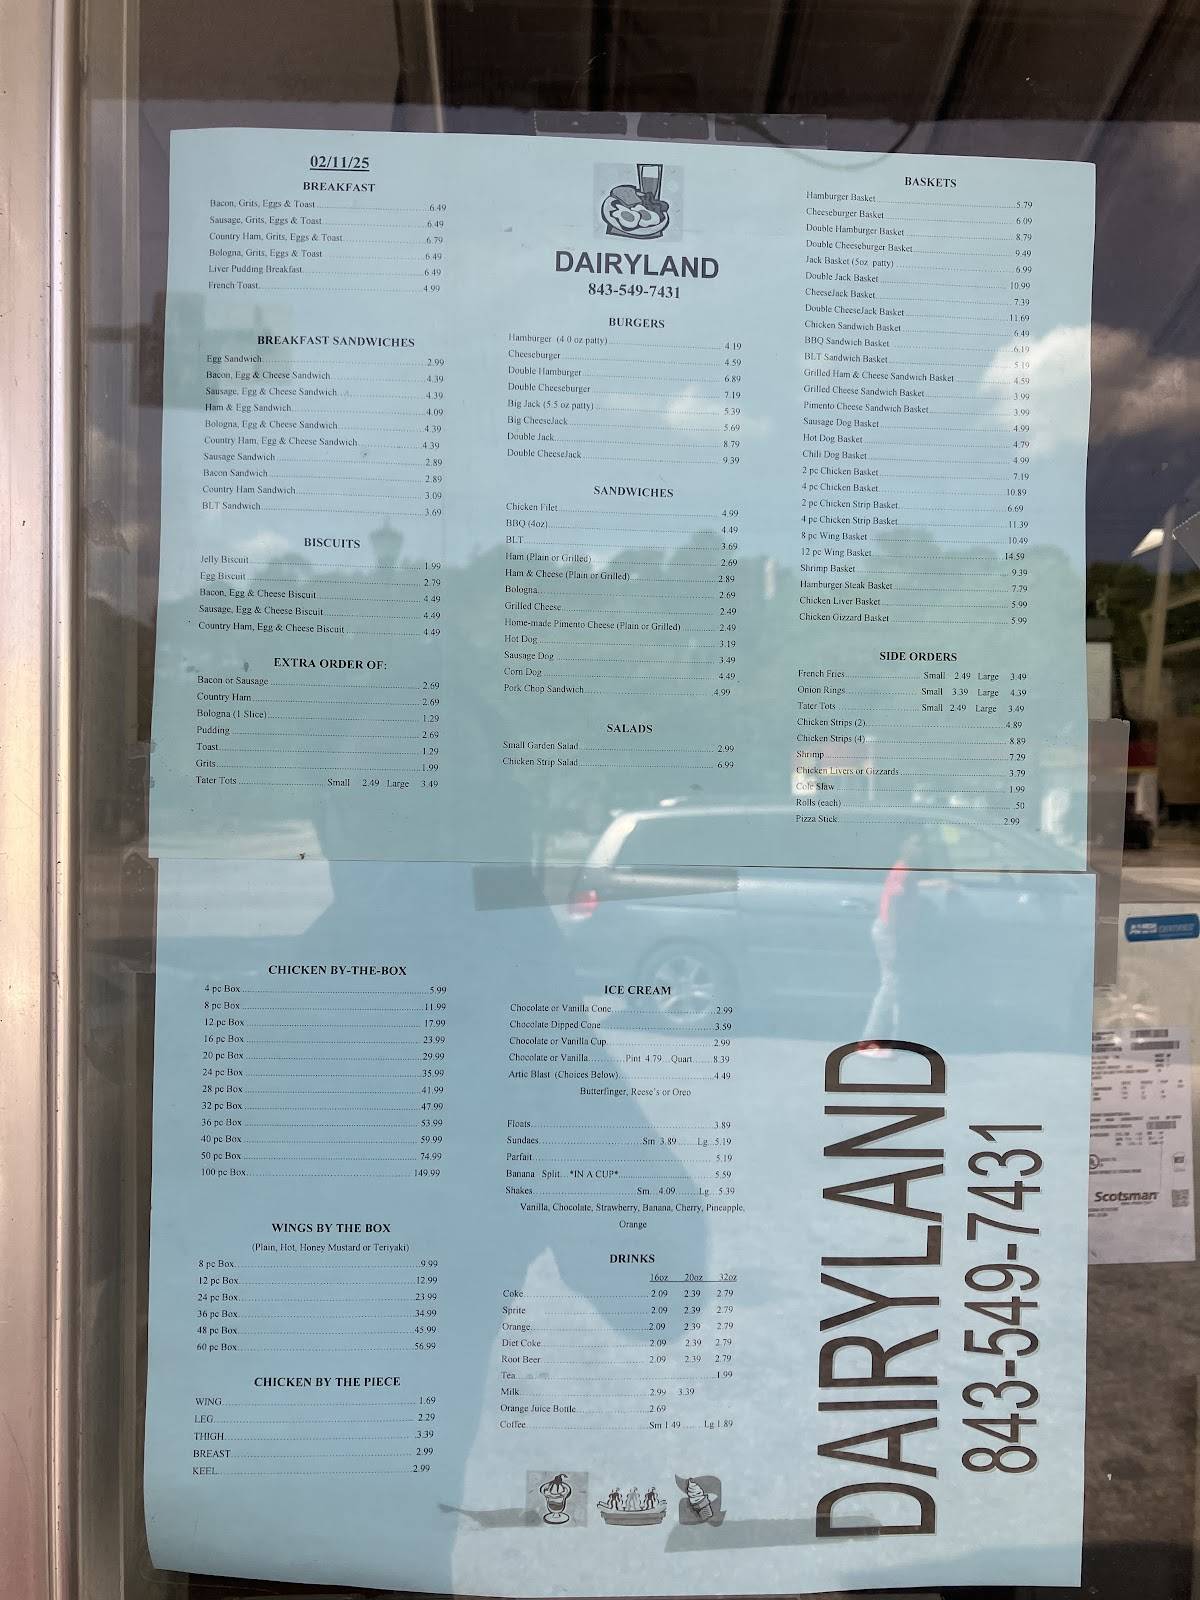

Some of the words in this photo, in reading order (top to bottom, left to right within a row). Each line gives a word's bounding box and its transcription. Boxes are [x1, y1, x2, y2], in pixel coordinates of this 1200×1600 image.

[309, 155, 370, 170] 02/11/25
[303, 181, 376, 193] BREAKFAST
[904, 176, 957, 188] BASKETS
[209, 199, 237, 209] Bacon,
[238, 200, 261, 209] Grits,
[262, 200, 282, 210] Eggs
[283, 201, 291, 209] &
[293, 200, 316, 209] Toast
[429, 203, 447, 212] 6.49
[806, 208, 857, 219] Cheeseburger
[859, 210, 884, 219] Basket
[1016, 217, 1033, 225] 6.09
[806, 223, 833, 233] Double
[835, 224, 877, 236] Hamburger
[879, 227, 905, 237] Basket
[1015, 233, 1032, 242] 8.79
[555, 250, 720, 279] DAIRYLAND
[208, 281, 235, 290] French
[236, 281, 258, 290] Toast
[423, 284, 441, 293] 4.99
[588, 282, 680, 299] 843-549-7431
[608, 317, 665, 329] BURGERS
[804, 320, 836, 329] Chicken
[837, 321, 874, 331] Sandwich
[876, 323, 901, 332] Basket
[1013, 329, 1030, 337] 6.49
[257, 335, 330, 346] BREAKFAST
[332, 336, 415, 348] SANDWICHES
[508, 349, 561, 362] Cheeseburger
[724, 358, 742, 367] 4.59
[206, 371, 233, 380] Bacon,
[235, 371, 250, 382] Egg
[252, 371, 260, 380] &
[262, 371, 290, 380] Cheese
[292, 371, 331, 381] Sandwich
[426, 375, 444, 384] 4.39
[508, 365, 535, 376] Double
[537, 367, 582, 378] Hamburger
[724, 375, 741, 383] 6.89
[803, 418, 833, 428] Sausage
[835, 418, 852, 429] Dog
[853, 419, 879, 428] Basket
[1013, 424, 1030, 433] 4.99
[507, 449, 534, 458] Double
[536, 449, 582, 460] CheeseJack
[722, 456, 740, 465] 9.39
[202, 485, 234, 495] Country
[236, 485, 255, 494] Ham
[256, 485, 296, 495] Sandwich
[425, 491, 442, 500] 3.09
[593, 485, 674, 498] SANDWICHES
[304, 537, 361, 549] BISCUITS
[800, 580, 843, 591] Hamburger
[844, 580, 866, 590] Steak
[868, 581, 893, 590] Basket
[1011, 584, 1028, 593] 7.79
[199, 588, 227, 598] Bacon,
[228, 588, 245, 599] Egg
[247, 588, 254, 597] &
[256, 588, 286, 598] Cheese
[288, 590, 316, 599] Biscuit
[423, 595, 441, 603] 4.49
[504, 601, 533, 611] Grilled
[534, 602, 561, 612] Cheese
[719, 607, 737, 616] 2.49
[504, 635, 520, 643] Hot
[521, 635, 538, 645] Dog
[719, 640, 736, 648] 3.19
[504, 651, 535, 661] Sausage
[537, 651, 554, 662] Dog
[718, 656, 736, 664] 3.49
[879, 651, 906, 662] SIDE
[909, 651, 958, 662] ORDERS
[273, 658, 316, 668] EXTRA
[319, 659, 364, 670] ORDER
[367, 659, 388, 670] OF:
[197, 676, 223, 685] Bacon
[225, 677, 234, 685] or
[235, 677, 269, 686] Sausage
[422, 681, 440, 690] 2.69
[797, 685, 821, 695] Onion
[823, 686, 846, 696] Rings
[921, 687, 943, 696] Small
[951, 687, 969, 696] 3.39
[977, 688, 1000, 698] Large
[1010, 688, 1027, 697] 4.39
[196, 725, 231, 736] Pudding
[422, 731, 439, 739] 2.69
[606, 723, 653, 733] SALADS
[796, 734, 829, 743] Chicken
[830, 734, 852, 745] Strips
[854, 734, 866, 744] (4)
[1009, 737, 1026, 746] 8.89
[503, 741, 525, 750] Small
[527, 741, 555, 750] Garden
[557, 741, 579, 750] Salad
[717, 745, 735, 753] 2.99
[195, 776, 217, 785] Tater
[218, 776, 237, 785] Tots
[327, 778, 350, 787] Small
[362, 779, 380, 787] 2.49
[386, 779, 410, 789] Large
[421, 779, 439, 788] 3.49
[268, 965, 327, 975] CHICKEN
[330, 965, 407, 976] BY-THE-BOX
[604, 985, 624, 995] ICE
[627, 985, 672, 995] CREAM
[204, 1018, 213, 1027] 12
[214, 1019, 226, 1028] pc
[227, 1018, 244, 1027] Box
[424, 1019, 446, 1028] 17.99
[509, 1020, 549, 1029] Chocolate
[550, 1020, 578, 1031] Dipped
[580, 1020, 601, 1030] Cone
[715, 1022, 732, 1031] 3.59
[201, 1102, 213, 1110] 32
[214, 1103, 224, 1112] pc
[225, 1101, 243, 1110] Box
[420, 1102, 444, 1111] 47.99
[1094, 1191, 1160, 1202] Scotsman
[520, 1203, 551, 1213] Vanilla,
[552, 1203, 594, 1213] Chocolate,
[596, 1203, 640, 1214] Strawberry,
[642, 1203, 673, 1213] Banana,
[675, 1203, 703, 1214] Cherry,
[705, 1203, 746, 1214] Pineapple,
[271, 1223, 314, 1233] WINGS
[316, 1223, 333, 1233] BY
[335, 1223, 362, 1233] THE
[364, 1223, 392, 1233] BOX
[619, 1220, 647, 1229] Orange
[609, 1253, 655, 1264] DRINKS
[502, 1289, 523, 1299] Coke
[651, 1289, 668, 1298] 2.09
[684, 1289, 701, 1298] 2.39
[716, 1289, 734, 1298] 2.79
[815, 1039, 946, 1538] DAIRYLAND
[197, 1293, 209, 1302] 24
[210, 1294, 221, 1303] pc
[222, 1293, 238, 1302] Box
[415, 1293, 437, 1301] 23.99
[961, 1124, 1043, 1474] 843-549-7431
[254, 1377, 311, 1387] CHICKEN
[315, 1377, 333, 1387] BY
[335, 1377, 361, 1387] THE
[364, 1377, 401, 1387] PIECE
[195, 1398, 222, 1407] WING
[419, 1396, 436, 1405] 1.69
[193, 1449, 231, 1459] BREAST
[416, 1447, 434, 1456] 2.99
